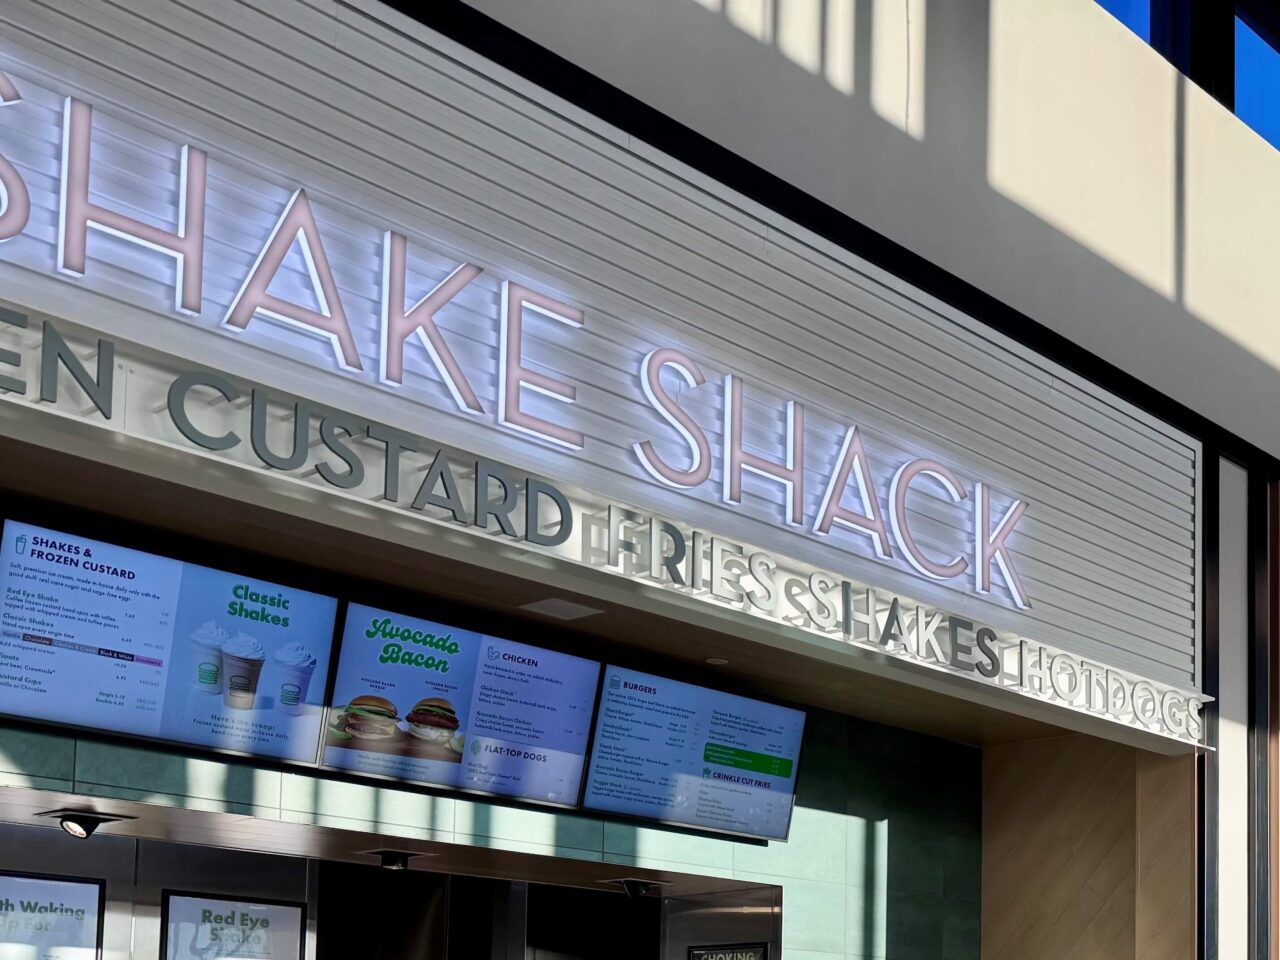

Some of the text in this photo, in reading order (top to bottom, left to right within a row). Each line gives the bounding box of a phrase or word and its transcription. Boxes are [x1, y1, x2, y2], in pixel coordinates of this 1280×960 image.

[632, 347, 1033, 611] SHACK
[166, 370, 573, 546] CUSTARD
[608, 504, 775, 612] FRIES
[808, 572, 999, 678] SHAKES
[31, 535, 92, 558] SHAKES &
[30, 548, 136, 580] FROZEN CUSTARD
[22, 589, 35, 598] Eye
[232, 583, 290, 610] Classic
[227, 601, 290, 627] Shakes
[365, 618, 460, 655] Avocado
[379, 643, 450, 674] Bacon
[502, 652, 538, 668] CHICKEN
[623, 681, 657, 695] BURGERS
[485, 744, 547, 763] FLAT-TOP DOGS
[712, 771, 771, 789] CRINKLE CUT FRIES
[19, 900, 85, 920] Waking
[201, 909, 270, 929] Red Eye
